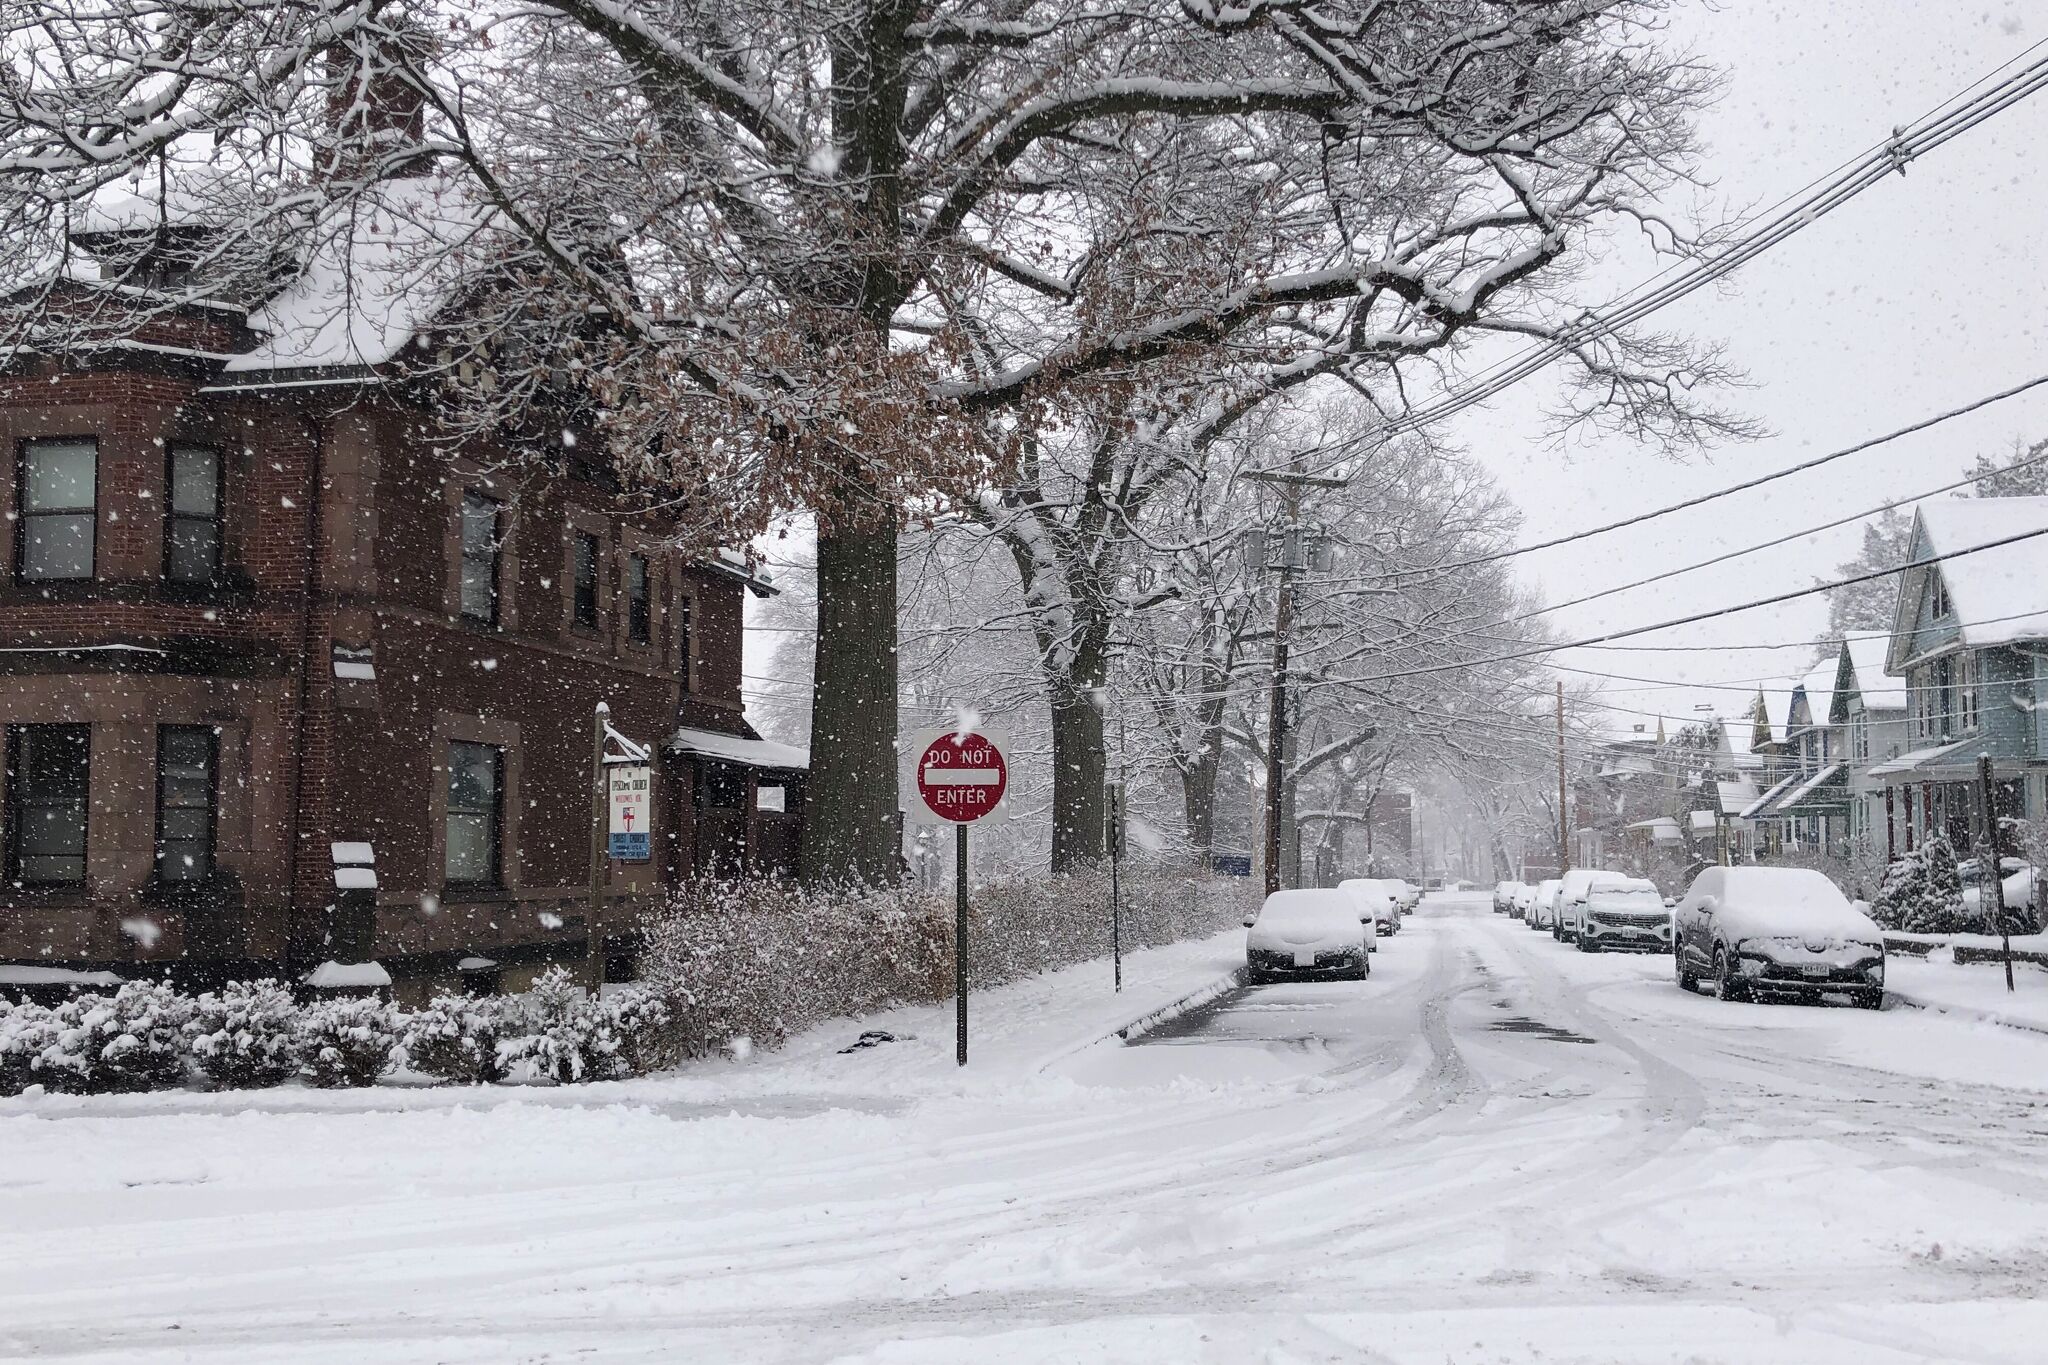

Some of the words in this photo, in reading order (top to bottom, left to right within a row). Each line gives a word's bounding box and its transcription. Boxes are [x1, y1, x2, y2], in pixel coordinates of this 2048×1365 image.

[930, 750, 951, 764] DO
[962, 750, 992, 764] NOT
[937, 789, 987, 804] ENTER
